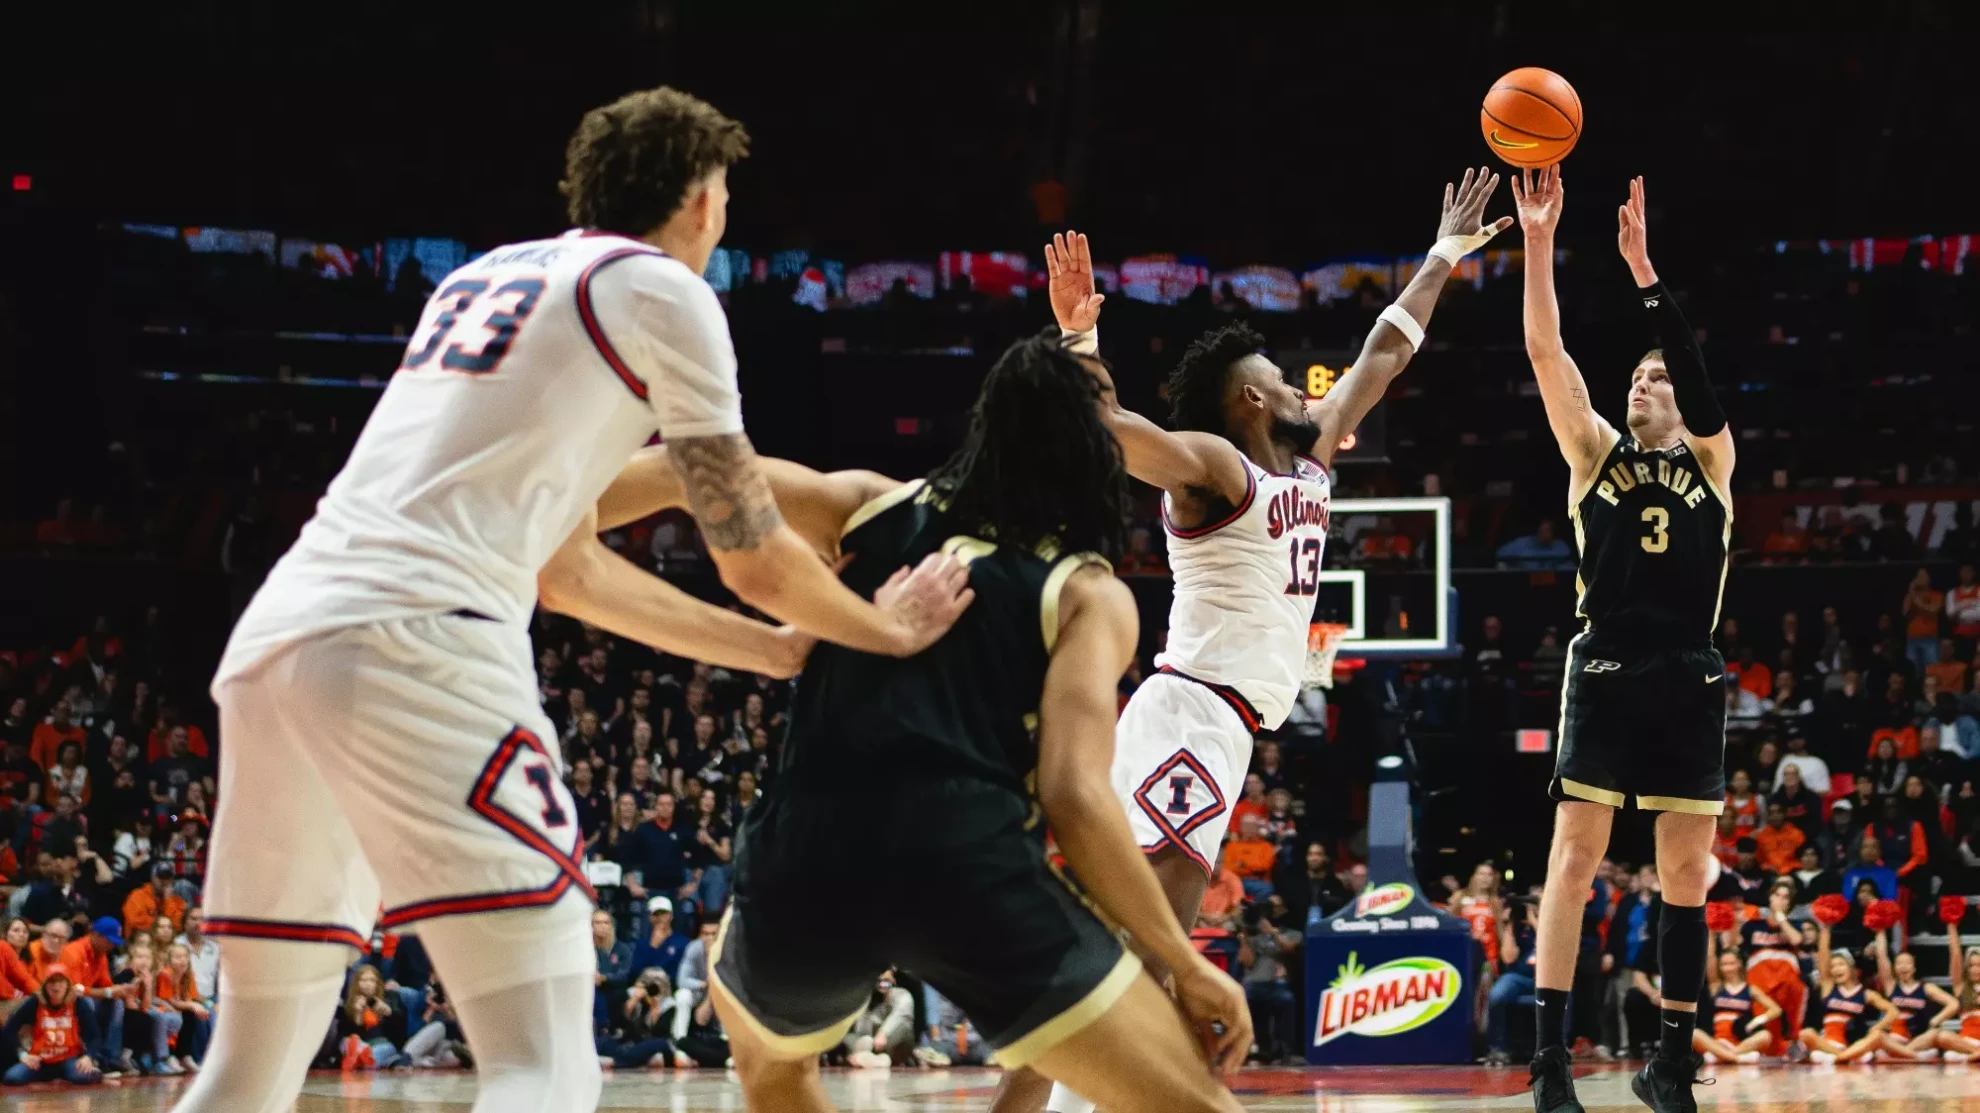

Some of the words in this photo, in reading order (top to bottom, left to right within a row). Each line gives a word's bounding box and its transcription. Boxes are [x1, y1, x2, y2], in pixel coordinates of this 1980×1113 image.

[402, 277, 546, 376] 33
[1596, 459, 1707, 509] PURDUE
[1641, 507, 1669, 553] 3
[1284, 538, 1320, 596] 13
[1166, 776, 1193, 814] I
[1321, 970, 1447, 1038] LIBMAN
